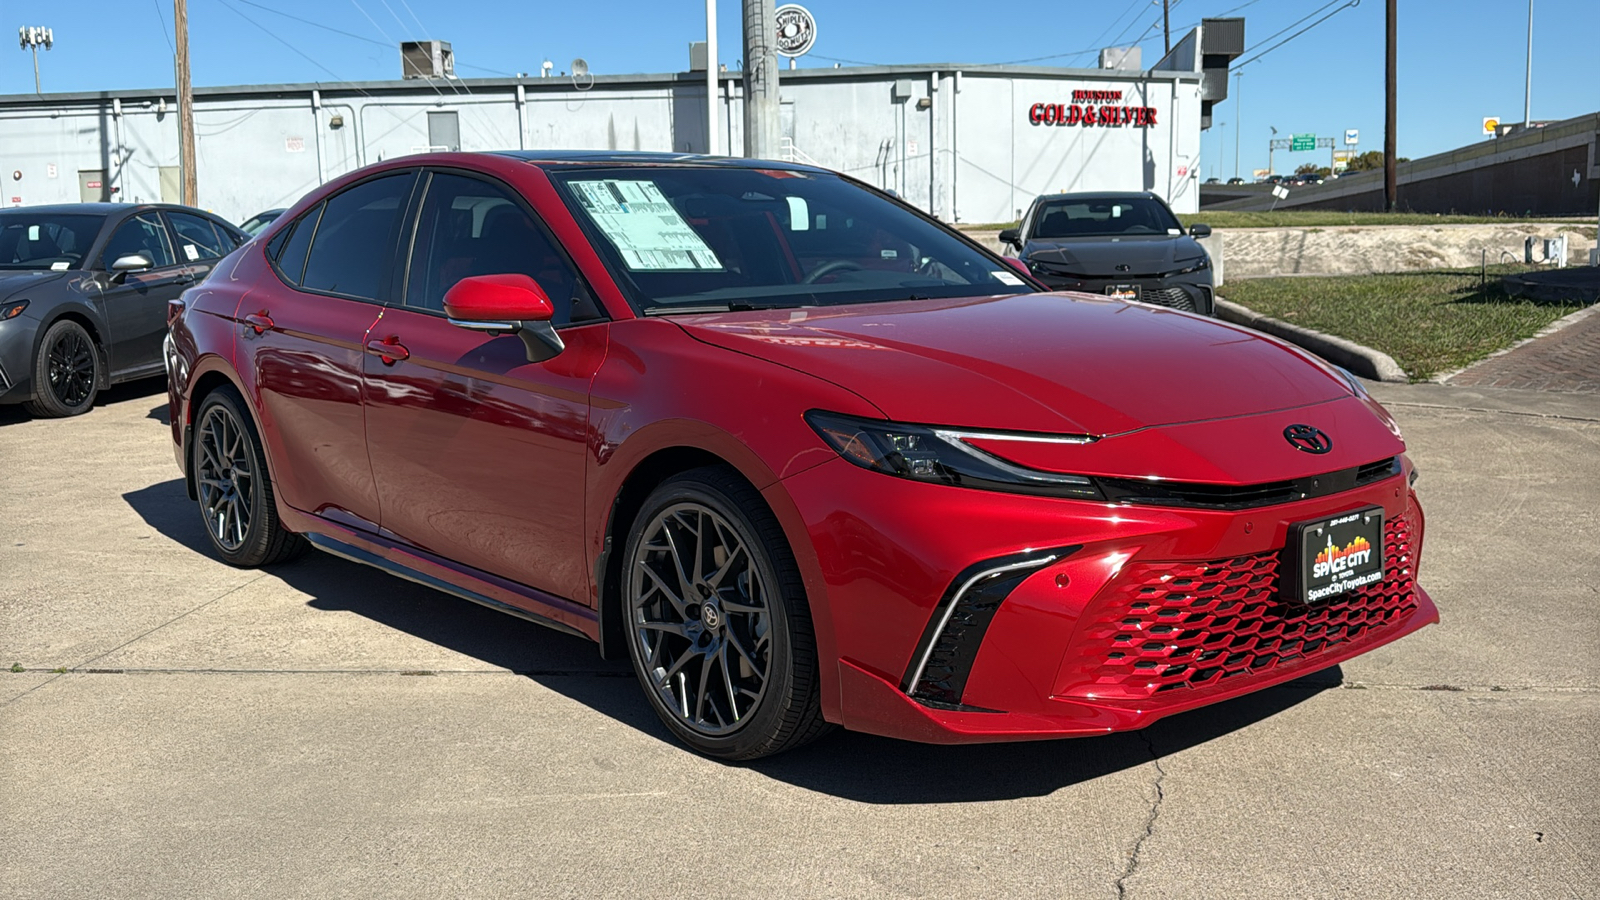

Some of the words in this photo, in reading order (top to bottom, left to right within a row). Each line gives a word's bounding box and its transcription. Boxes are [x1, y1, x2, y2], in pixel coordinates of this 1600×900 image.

[1073, 89, 1123, 100] HOUSTON
[1313, 555, 1346, 578] SPACE
[1347, 549, 1371, 567] CITY
[1338, 569, 1354, 579] TOYOTA
[1308, 571, 1382, 601] SpaceCityToyota.com
